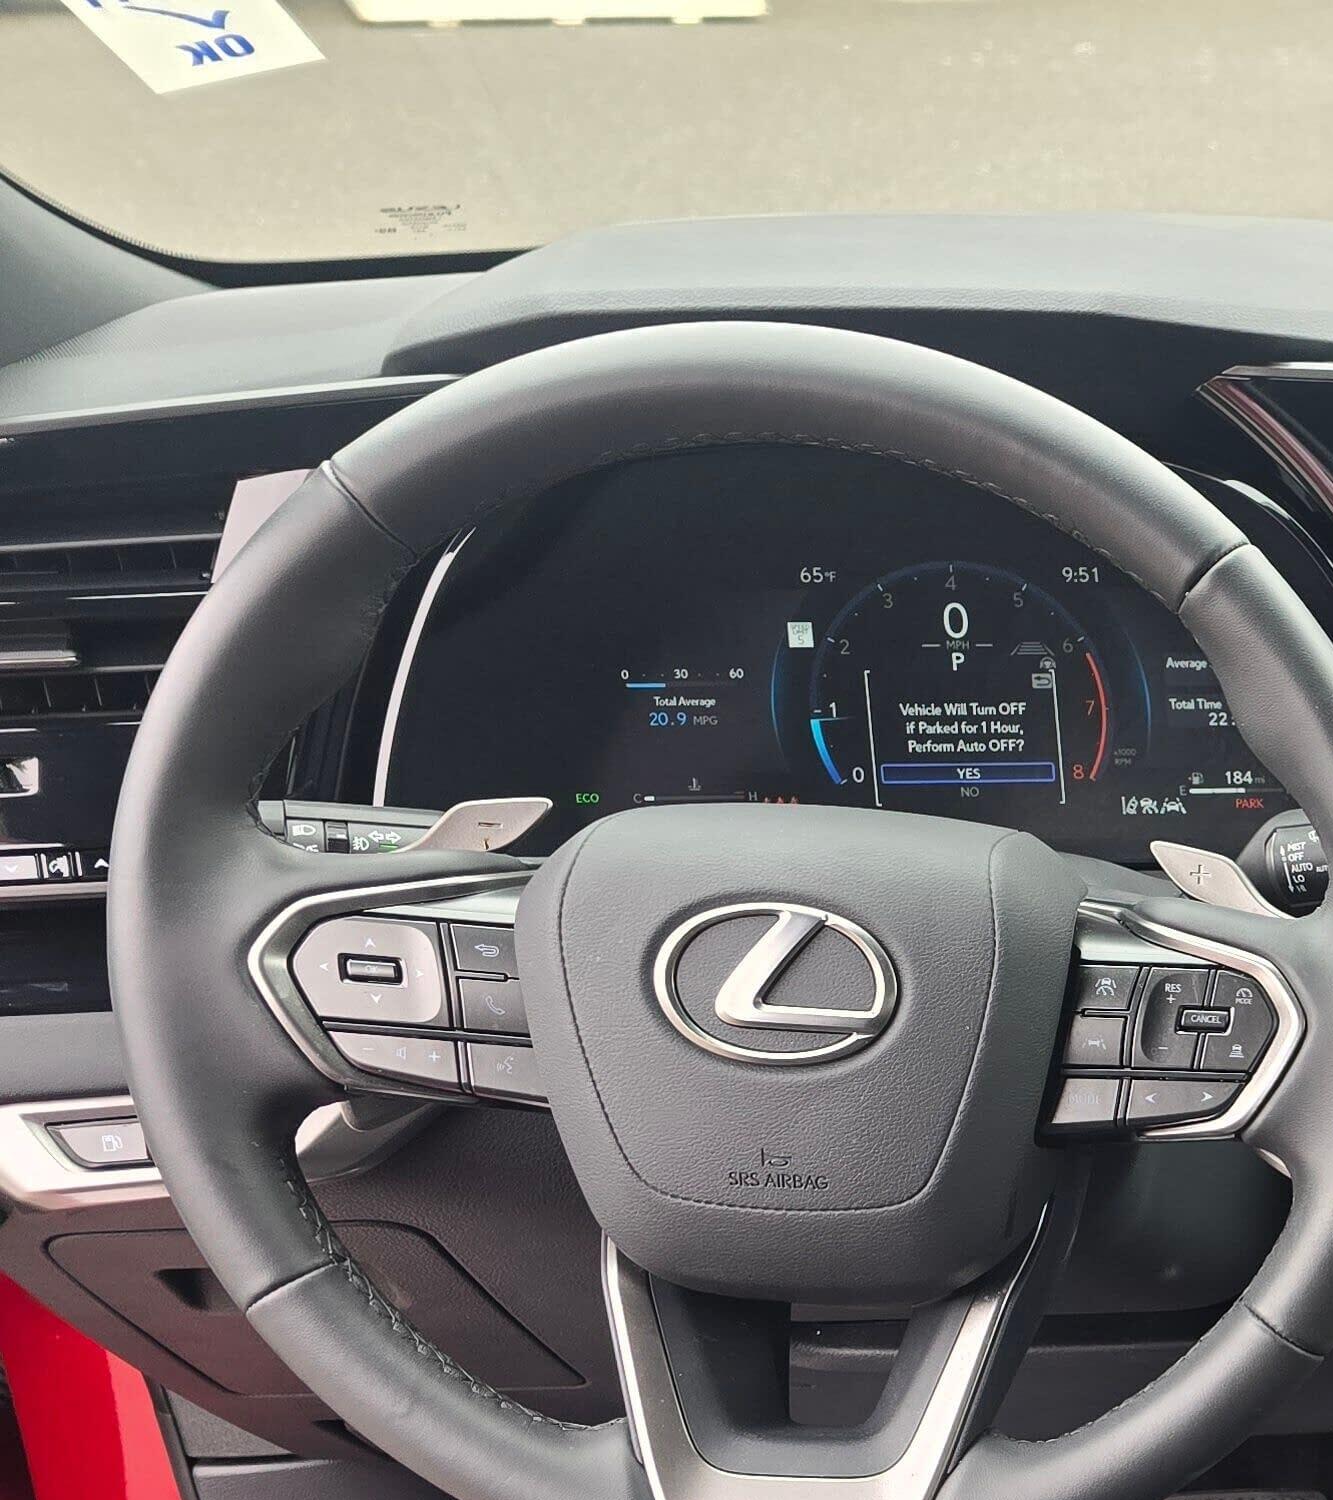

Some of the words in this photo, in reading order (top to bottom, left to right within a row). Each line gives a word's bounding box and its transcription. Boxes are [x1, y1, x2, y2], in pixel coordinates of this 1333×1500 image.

[799, 566, 837, 584] 65°F
[1061, 566, 1100, 583] 9:51
[944, 575, 956, 591] 4
[882, 593, 894, 608] 3
[1013, 592, 1024, 608] 5
[943, 602, 969, 639] 0
[839, 639, 850, 655] 2
[946, 640, 970, 650] MPH
[1062, 638, 1074, 653] 6
[951, 652, 965, 671] P
[1166, 657, 1208, 671] Average
[620, 669, 630, 680] 0
[673, 668, 689, 680] 30
[729, 668, 744, 679] 60
[653, 696, 677, 707] Total
[678, 696, 716, 708] Average
[899, 702, 942, 717] Vehicle
[944, 701, 967, 716] Will
[968, 702, 997, 716] Turn
[998, 702, 1026, 716] OFF
[1085, 701, 1095, 716] 7
[1169, 698, 1195, 710] Total
[1196, 698, 1223, 710] Time
[828, 702, 837, 718] 1
[649, 711, 687, 727] 20.9
[693, 715, 719, 726] MPG
[905, 721, 916, 734] if
[918, 721, 959, 734] Parked
[961, 720, 979, 734] for
[989, 721, 1024, 735] Hour,
[908, 739, 955, 753] Perform
[956, 739, 987, 753] Auto
[987, 738, 1025, 753] OFF?
[852, 766, 866, 783] 0
[956, 767, 981, 780] YES
[1072, 764, 1085, 780] 8
[1224, 771, 1254, 785] 184
[748, 791, 758, 802] H
[960, 786, 980, 798] NO
[1179, 785, 1188, 796] E
[575, 793, 600, 804] ECO
[633, 793, 642, 804] C
[1235, 798, 1265, 809] PARK
[1288, 852, 1305, 862] OFF
[1291, 862, 1314, 874] AUTO
[1292, 874, 1306, 883] LO
[1164, 983, 1182, 993] RES
[1190, 1014, 1222, 1024] CANCEL
[728, 1171, 760, 1187] SRS
[764, 1173, 829, 1191] AIRBAG
